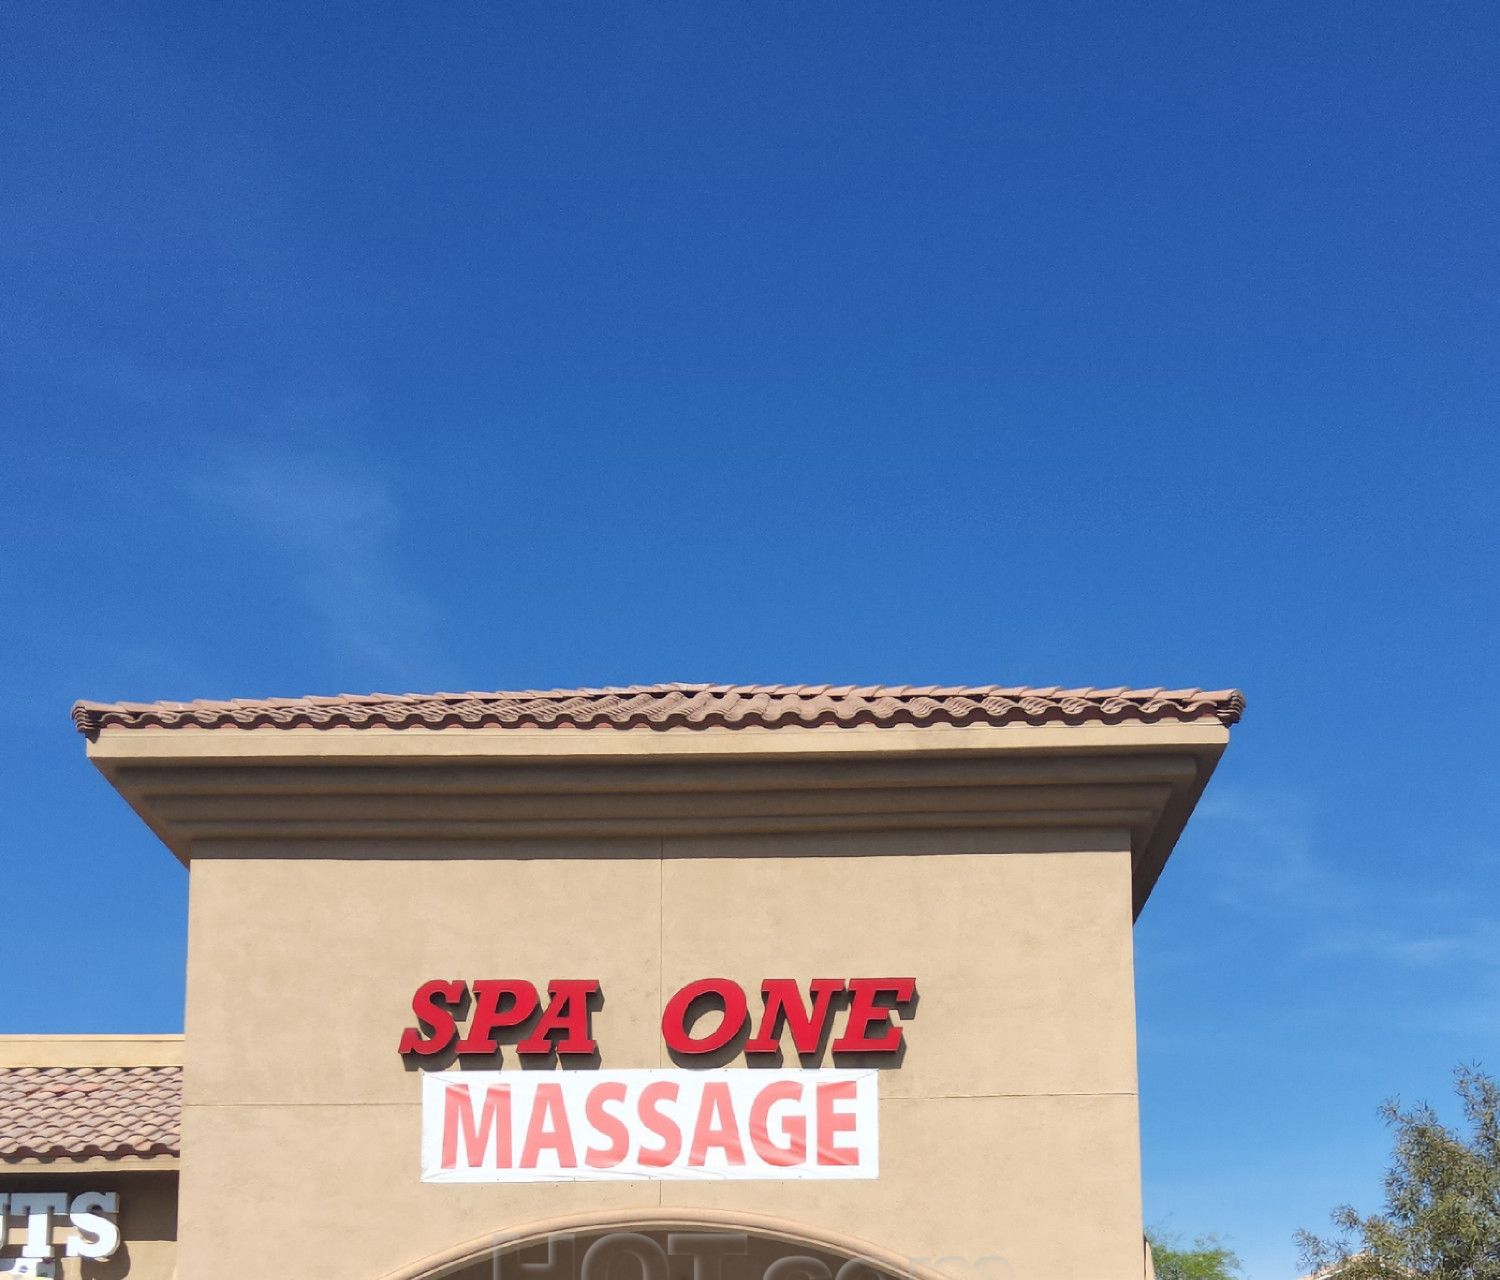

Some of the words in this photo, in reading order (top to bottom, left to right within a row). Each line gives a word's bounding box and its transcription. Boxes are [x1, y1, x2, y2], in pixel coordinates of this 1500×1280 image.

[398, 979, 603, 1055] SPA
[661, 977, 917, 1055] ONE
[440, 1080, 861, 1170] MASSAGE
[0, 1191, 120, 1258] TS
